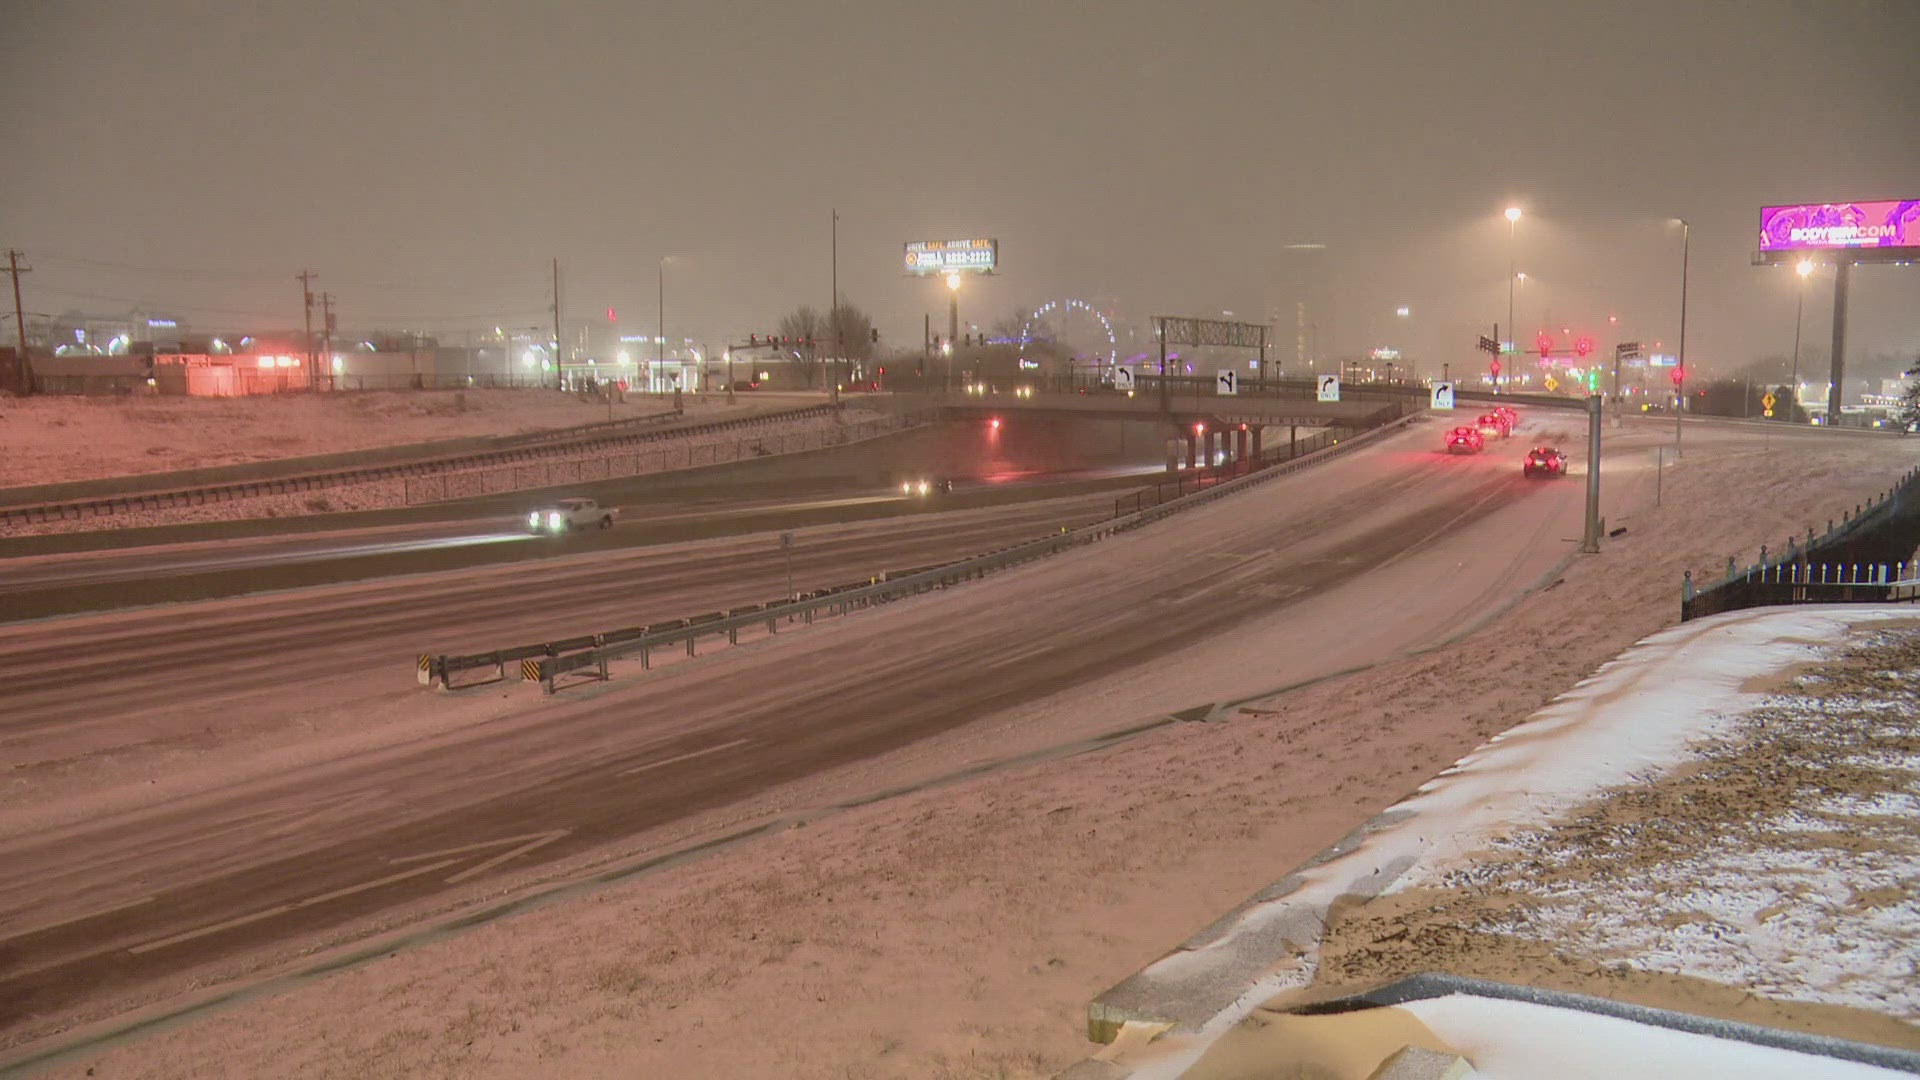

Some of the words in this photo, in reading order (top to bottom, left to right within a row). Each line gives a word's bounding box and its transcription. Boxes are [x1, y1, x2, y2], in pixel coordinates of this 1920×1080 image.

[907, 242, 926, 251] DRIVE
[946, 239, 971, 249] ARRIVE
[971, 239, 991, 249] SAFE.
